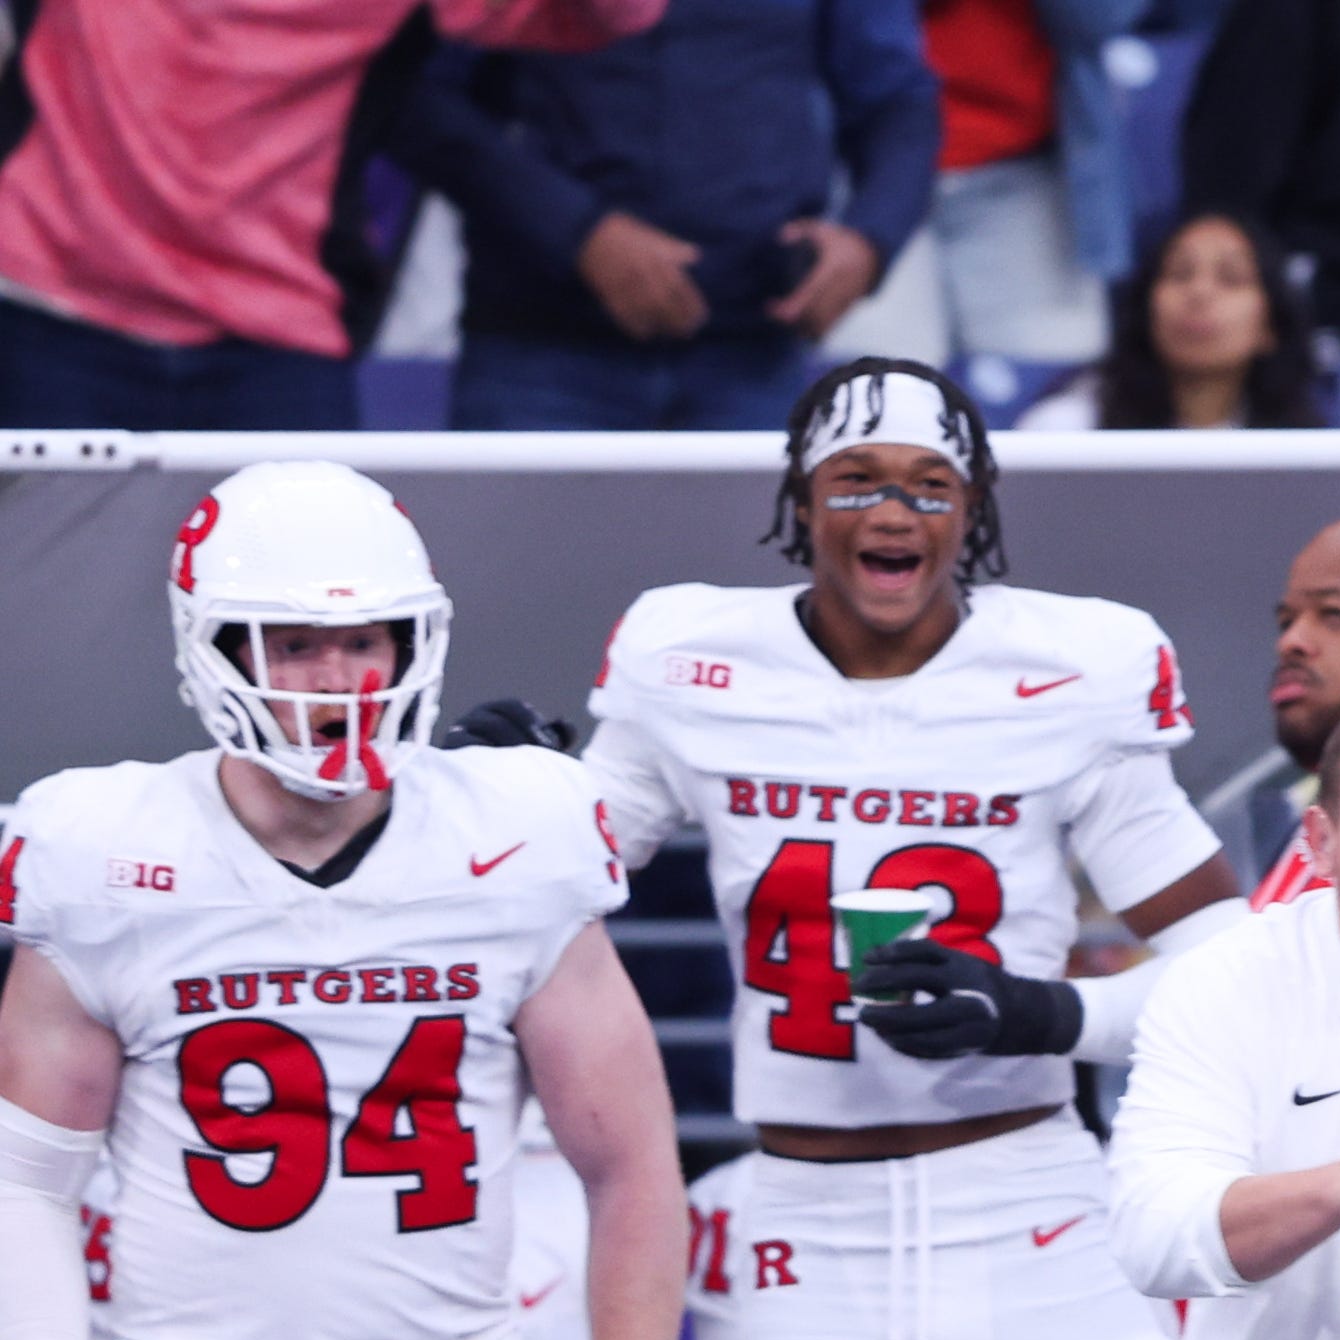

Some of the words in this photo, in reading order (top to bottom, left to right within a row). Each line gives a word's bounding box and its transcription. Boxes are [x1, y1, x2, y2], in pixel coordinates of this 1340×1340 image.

[1148, 644, 1195, 730] 4
[727, 777, 1021, 827] RUTGERS
[174, 963, 481, 1014] RUTGERS
[177, 1013, 478, 1234] 94
[752, 1239, 798, 1289] R
